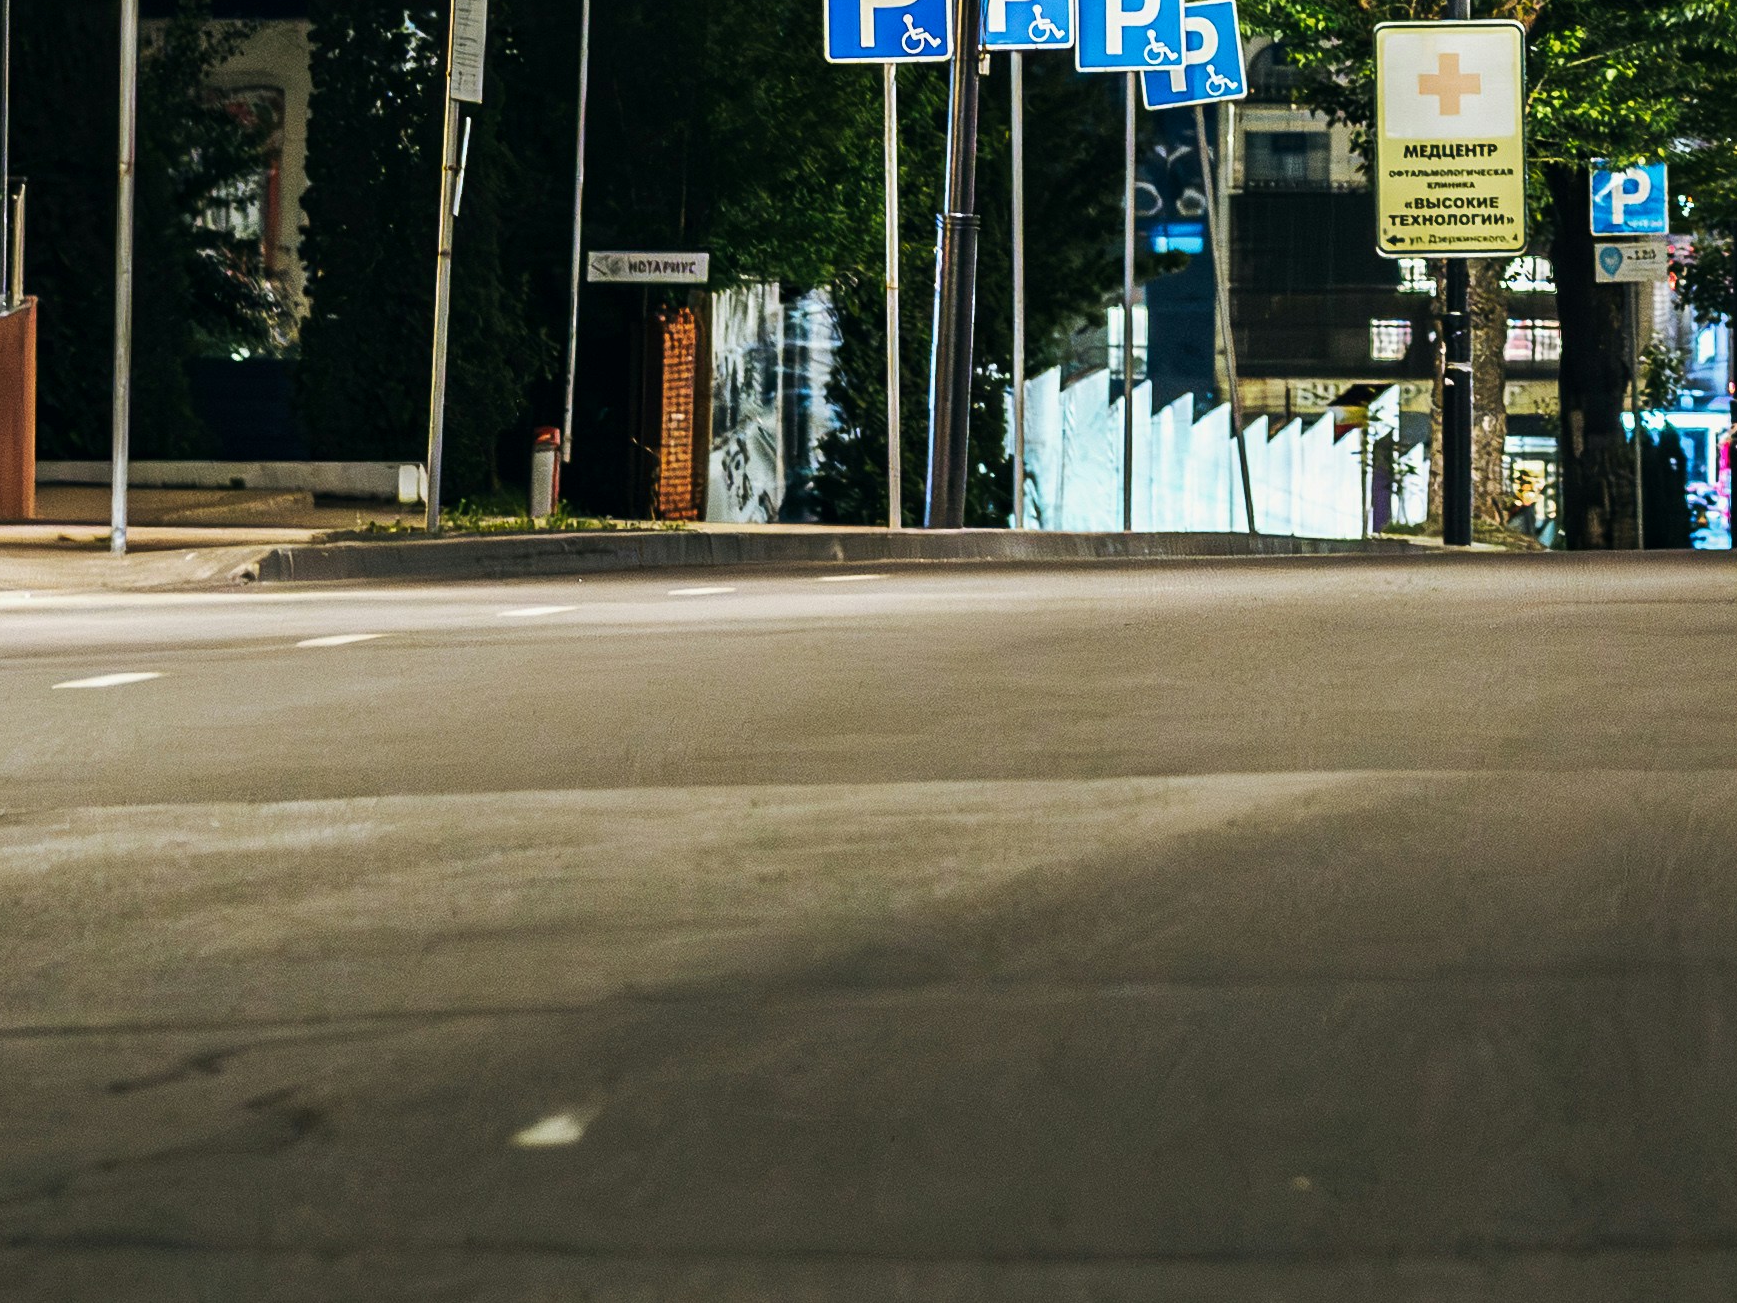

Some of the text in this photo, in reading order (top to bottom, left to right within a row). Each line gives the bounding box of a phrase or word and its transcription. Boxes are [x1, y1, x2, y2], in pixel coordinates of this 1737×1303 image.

[1403, 143, 1498, 160] МЕДЦЕНТР
[1388, 168, 1514, 178] ОФТАЛЬМОЛОГИЧЕСКАЯ
[1426, 181, 1476, 190] КЛИНИКА
[1611, 167, 1651, 224] P
[1404, 197, 1499, 209] «ВЫСОКИЕ
[1388, 214, 1515, 226] ТЕХНОЛОГИИ»
